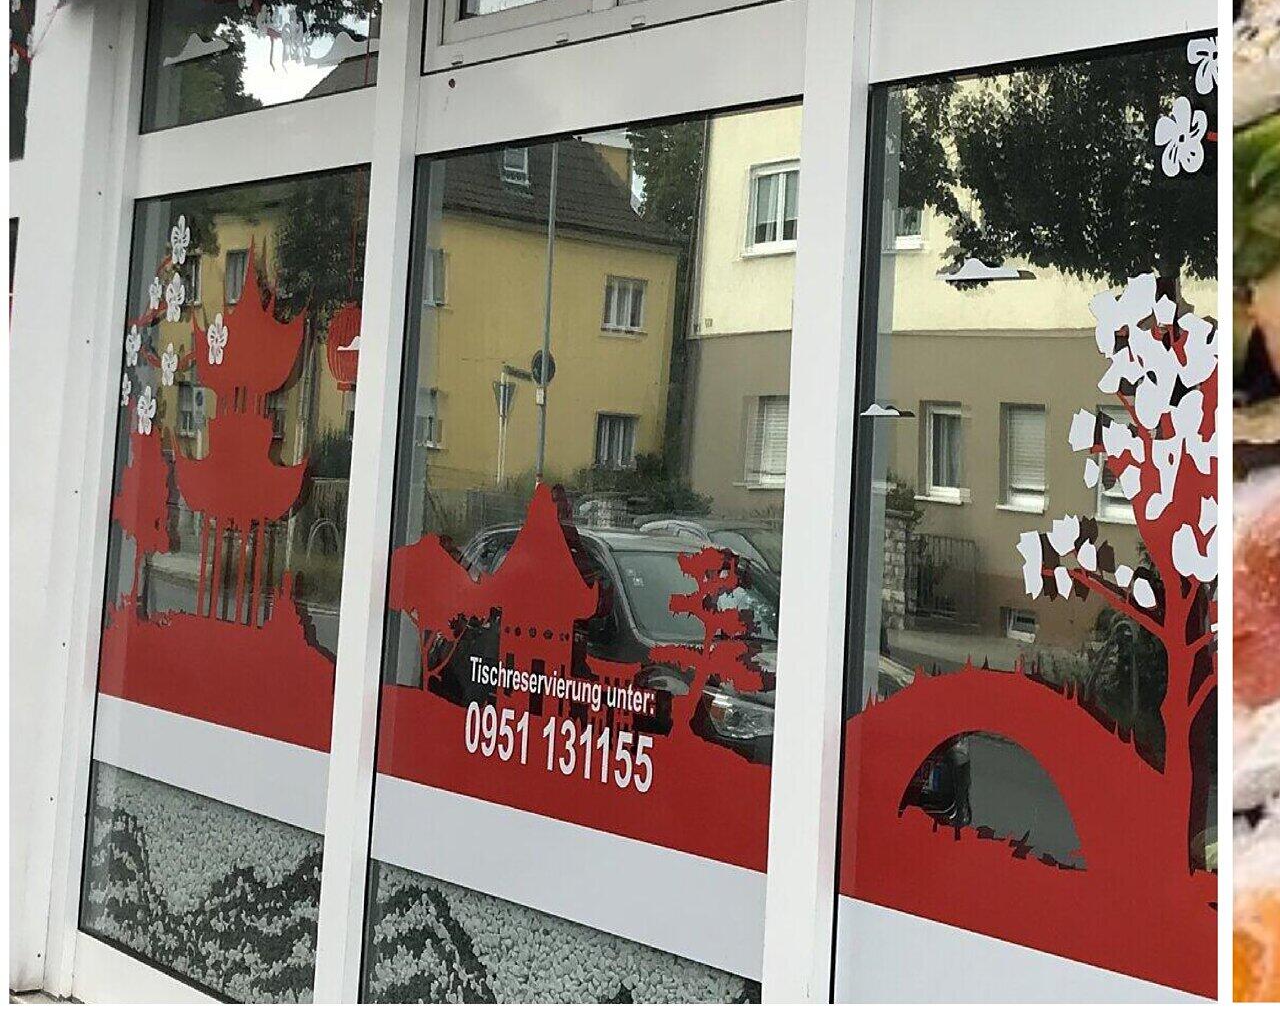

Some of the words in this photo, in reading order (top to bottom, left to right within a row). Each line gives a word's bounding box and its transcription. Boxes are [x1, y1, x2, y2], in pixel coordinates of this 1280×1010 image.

[470, 655, 602, 713] Tischreservierung
[606, 683, 655, 715] unter:
[465, 701, 530, 765] 0951
[542, 716, 654, 794] 131155
